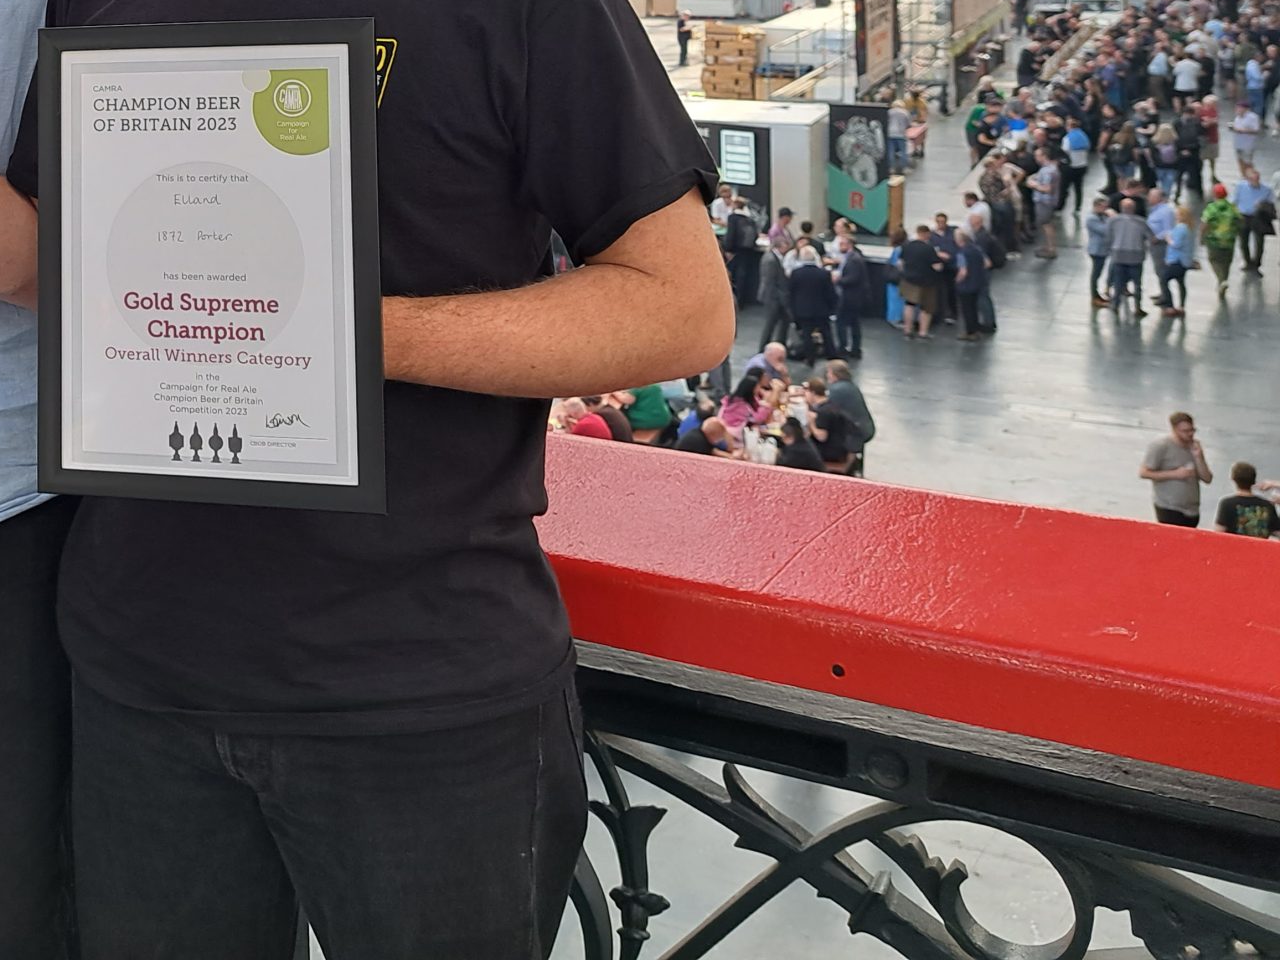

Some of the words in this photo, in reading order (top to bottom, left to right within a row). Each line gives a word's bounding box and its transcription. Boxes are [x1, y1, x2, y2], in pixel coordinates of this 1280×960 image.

[93, 85, 123, 93] CAMRA
[93, 97, 191, 112] CHAMPION
[196, 96, 241, 110] BEER
[93, 118, 116, 132] OF
[121, 117, 192, 132] BRITAIN
[197, 117, 237, 131] 2023
[156, 174, 175, 182] This
[177, 174, 184, 182] is
[186, 174, 196, 182] to
[198, 174, 228, 184] certify
[230, 174, 249, 183] that
[158, 231, 184, 242] 1872
[197, 230, 233, 242] Porter
[163, 271, 179, 281] has
[181, 272, 205, 281] been
[206, 273, 247, 282] awarded
[123, 291, 174, 311] Gold
[179, 292, 280, 316] Supreme
[147, 319, 266, 344] Champion
[105, 346, 160, 362] Overall
[164, 348, 232, 365] Winners
[237, 351, 312, 370] Category
[195, 372, 203, 381] in
[205, 373, 220, 381] the
[159, 382, 203, 393] Campaign
[205, 383, 218, 392] for
[221, 384, 240, 393] Real
[242, 385, 257, 394] Ale
[153, 393, 198, 404] Champion
[200, 395, 220, 404] Beer
[223, 395, 232, 404] of
[234, 396, 264, 406] Britain
[169, 404, 223, 415] Competition
[225, 407, 248, 416] 2023
